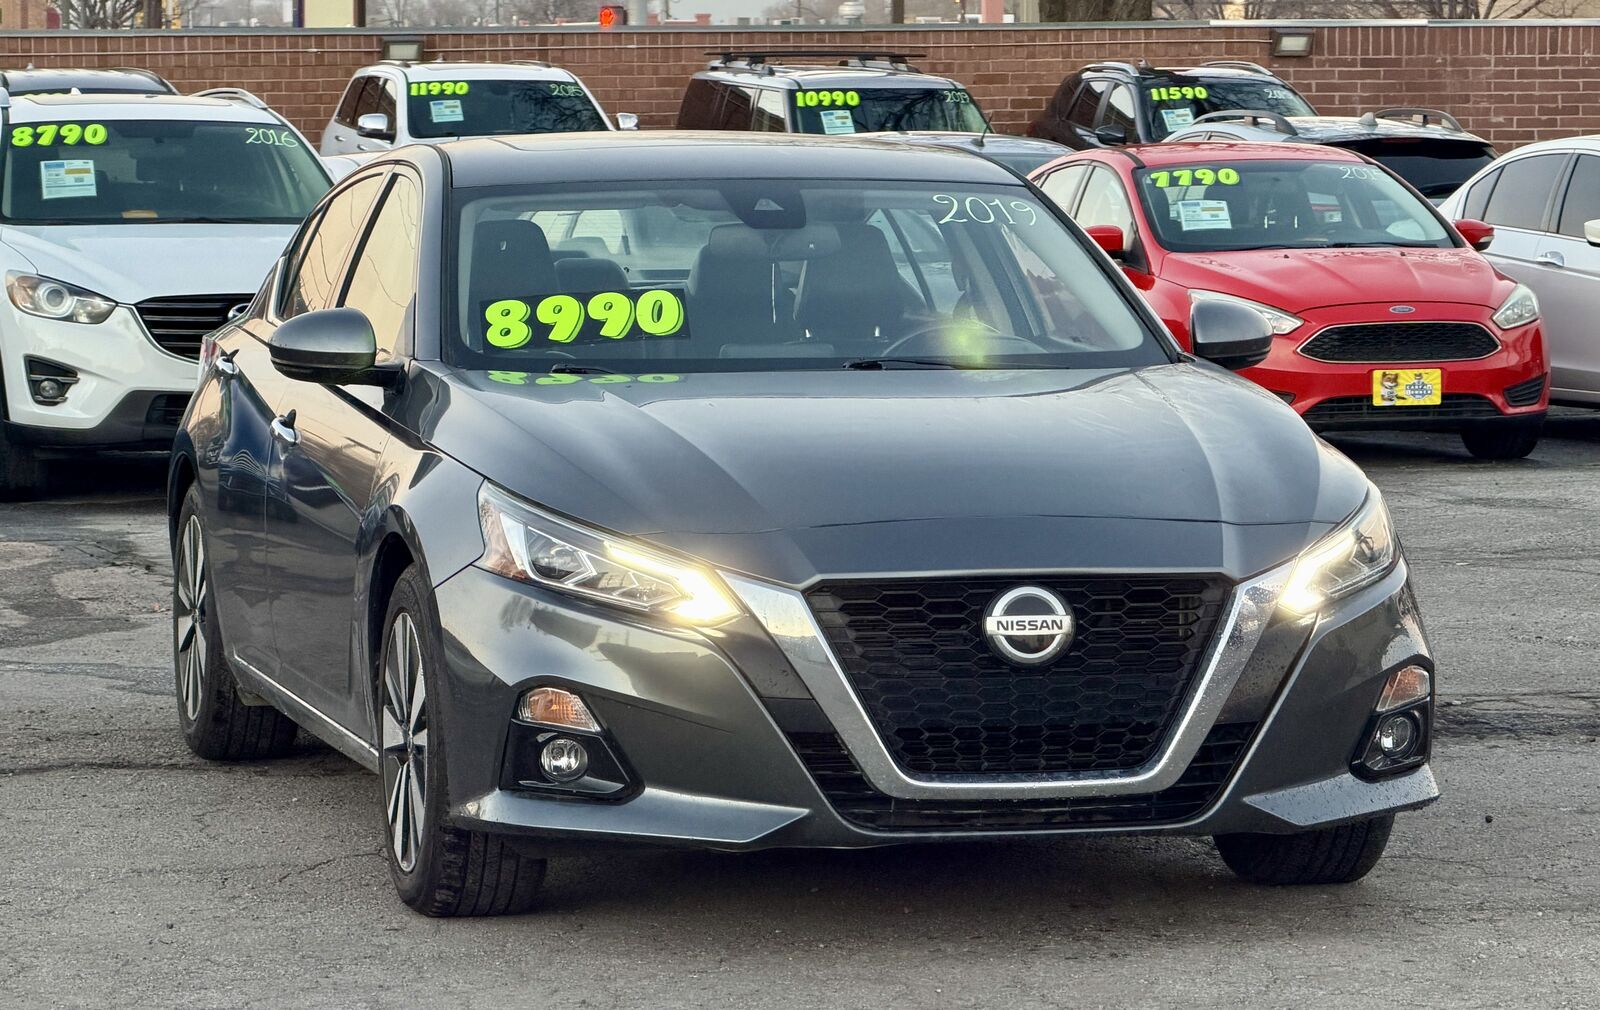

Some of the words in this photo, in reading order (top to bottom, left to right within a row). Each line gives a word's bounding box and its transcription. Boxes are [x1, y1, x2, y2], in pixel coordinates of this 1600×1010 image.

[410, 81, 469, 96] 11990
[1151, 86, 1208, 100] 11590
[796, 91, 860, 107] 10990
[11, 123, 108, 147] 8790
[245, 127, 299, 148] 2016
[1150, 168, 1240, 188] 7790
[932, 194, 1037, 226] 2019
[485, 289, 685, 349] 8990
[996, 619, 1063, 631] NISSAN
